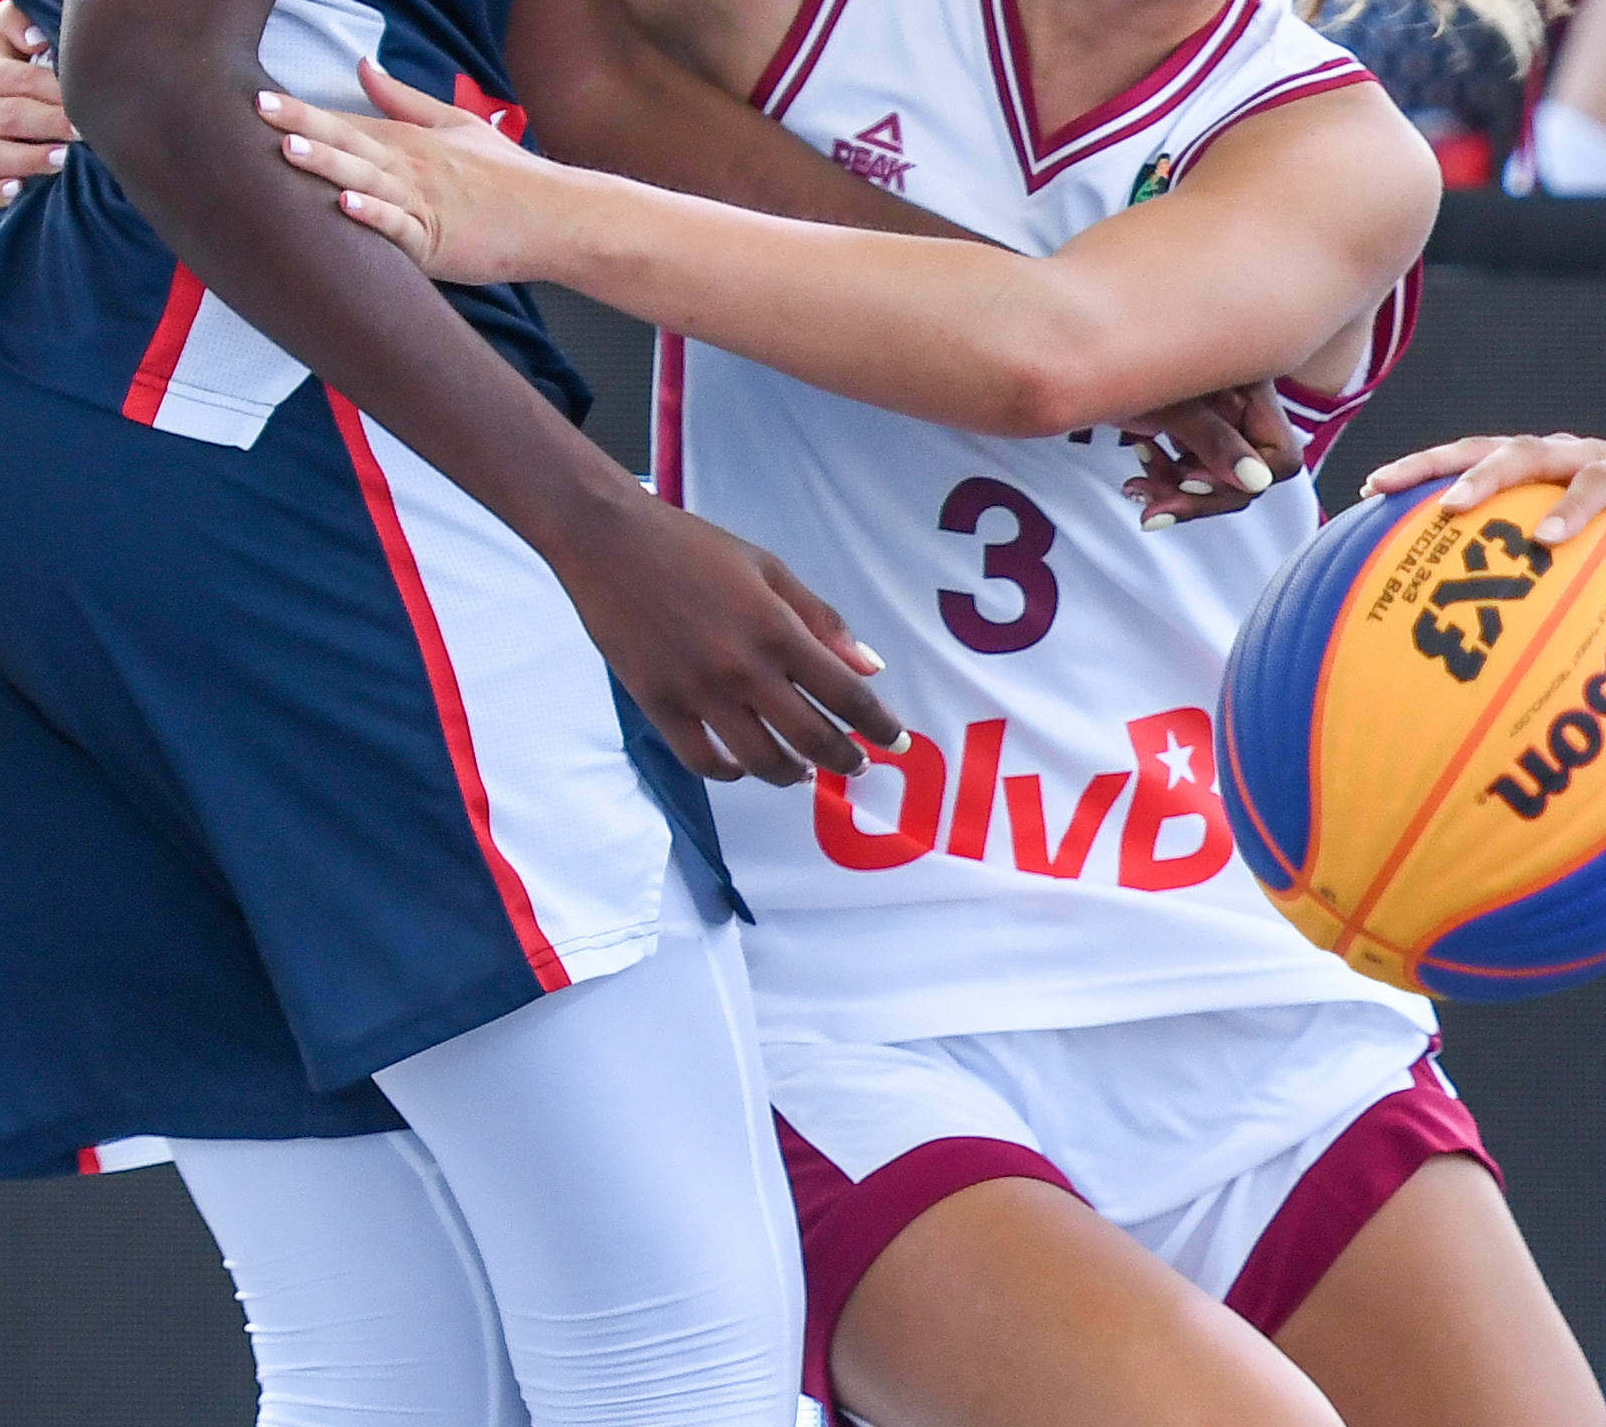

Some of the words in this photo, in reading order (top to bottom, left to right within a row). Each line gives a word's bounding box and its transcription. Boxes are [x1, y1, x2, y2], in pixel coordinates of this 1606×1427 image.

[833, 138, 916, 192] PEAK
[937, 476, 1059, 655] 3
[1426, 526, 1462, 566] FIBA
[1366, 576, 1403, 622] BALL
